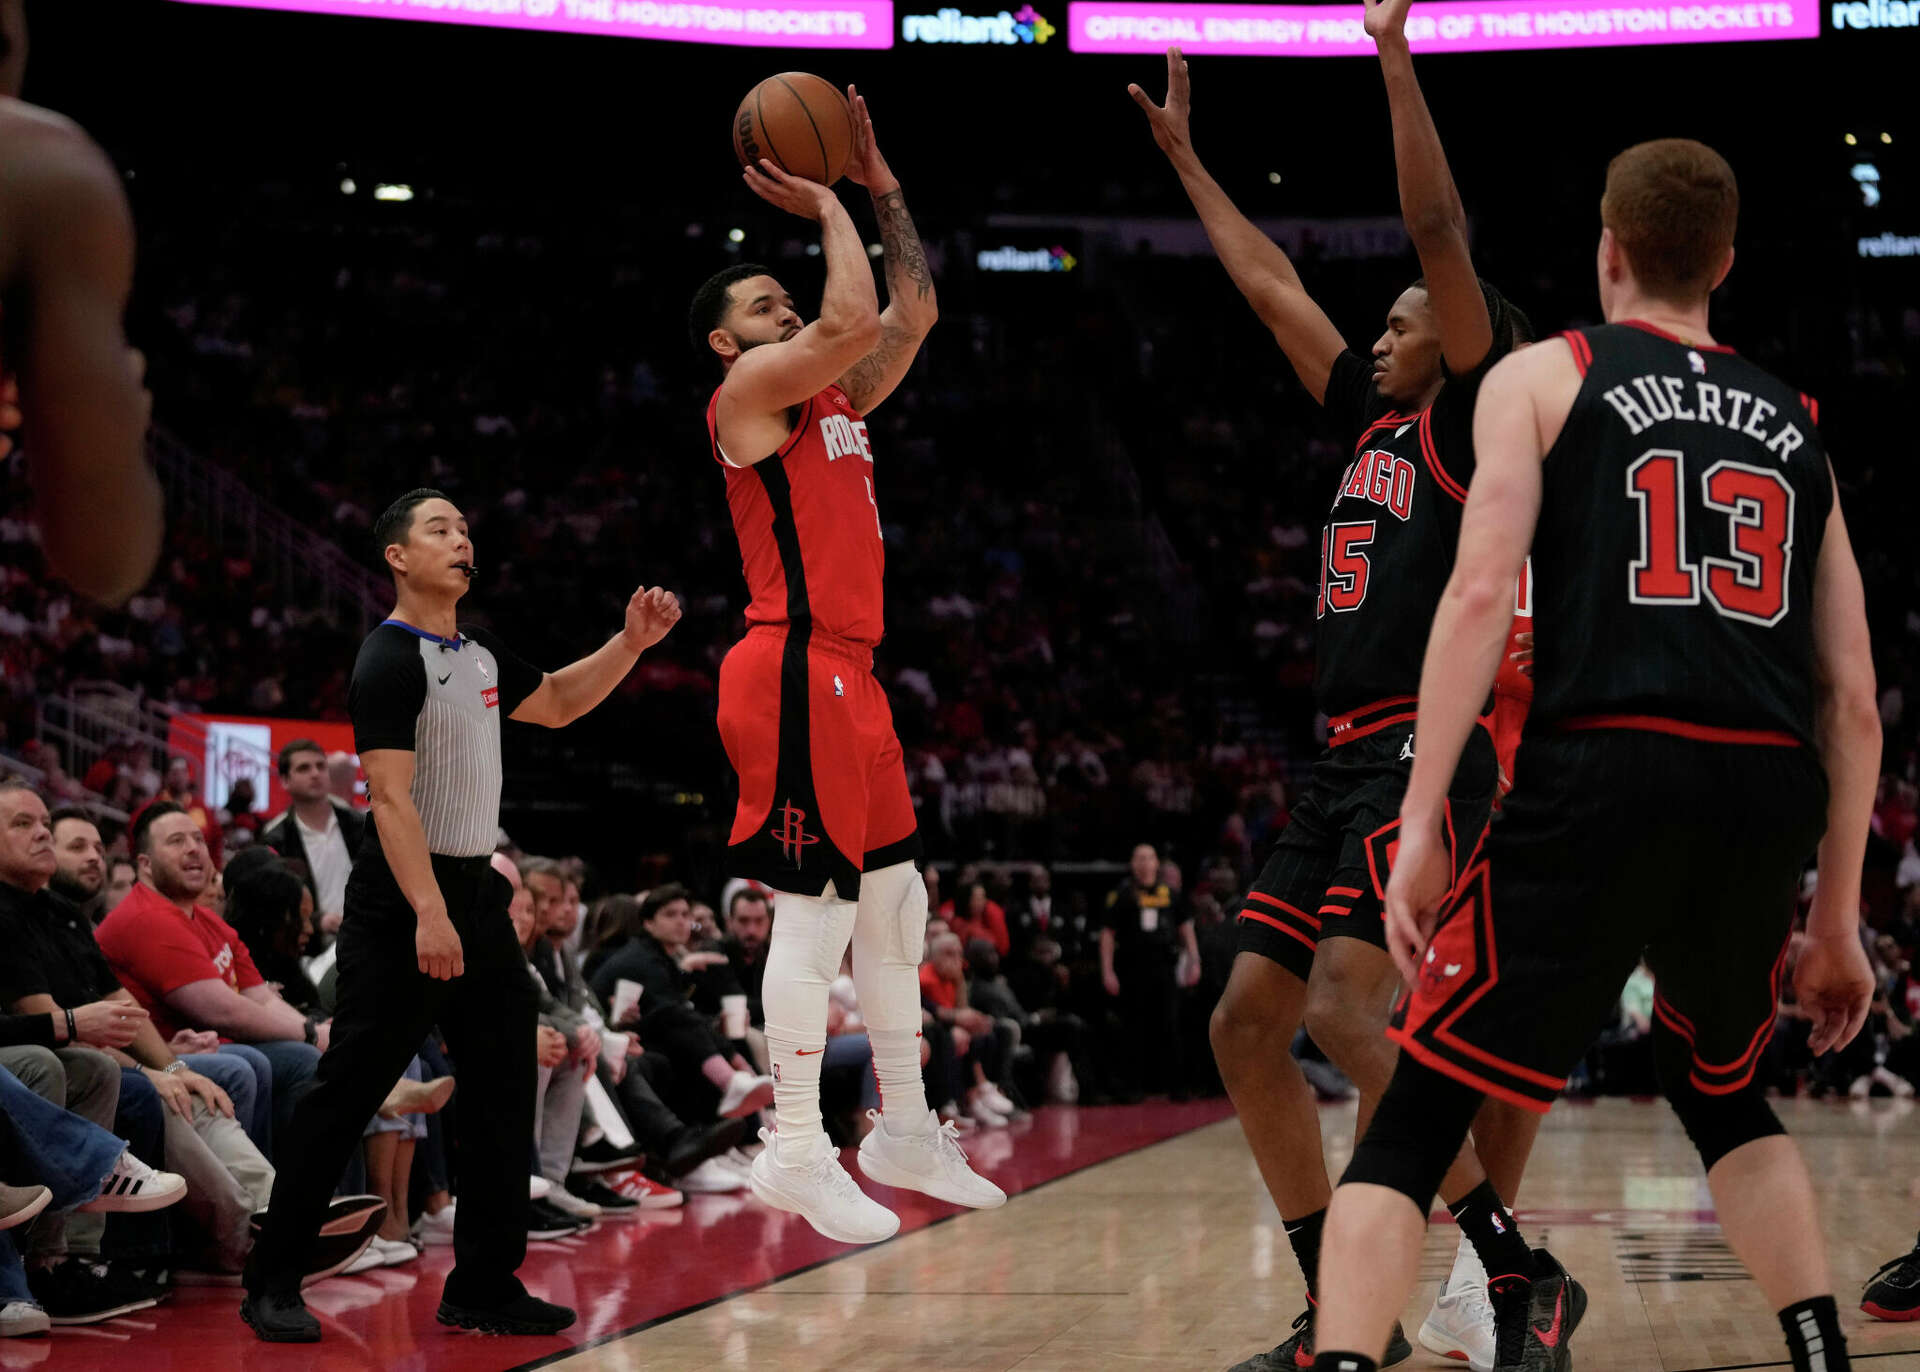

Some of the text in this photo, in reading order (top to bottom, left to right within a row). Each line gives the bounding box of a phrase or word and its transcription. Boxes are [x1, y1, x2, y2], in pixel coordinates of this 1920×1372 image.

[563, 0, 614, 22] THE
[617, 1, 743, 33] HOUSTON
[745, 9, 866, 36] ROCKETS
[902, 8, 1018, 44] reliant
[1085, 15, 1202, 41] OFFICIAL
[1203, 17, 1304, 43] ENERGY
[1438, 15, 1475, 40] OF
[1479, 13, 1533, 38] THE
[1534, 8, 1667, 36] HOUSTON
[1669, 3, 1793, 31] ROCKETS
[977, 246, 1051, 272] reliant
[1603, 374, 1804, 463] HUERTER
[1626, 448, 1795, 628] 13
